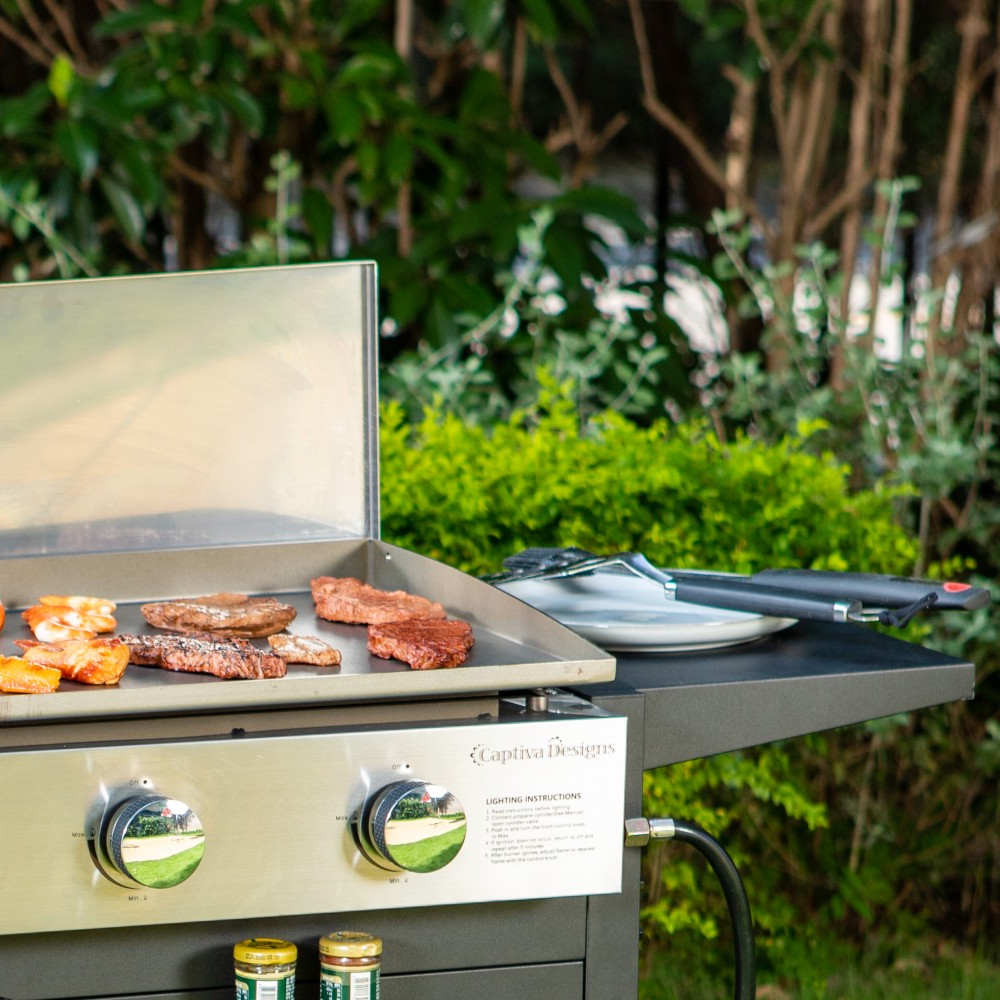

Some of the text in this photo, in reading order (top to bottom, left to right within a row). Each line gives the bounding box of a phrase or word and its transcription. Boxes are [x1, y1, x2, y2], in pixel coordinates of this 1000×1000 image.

[478, 741, 616, 765] Captiva Designs
[486, 792, 582, 805] LIGHTING INSTRUCTIONS
